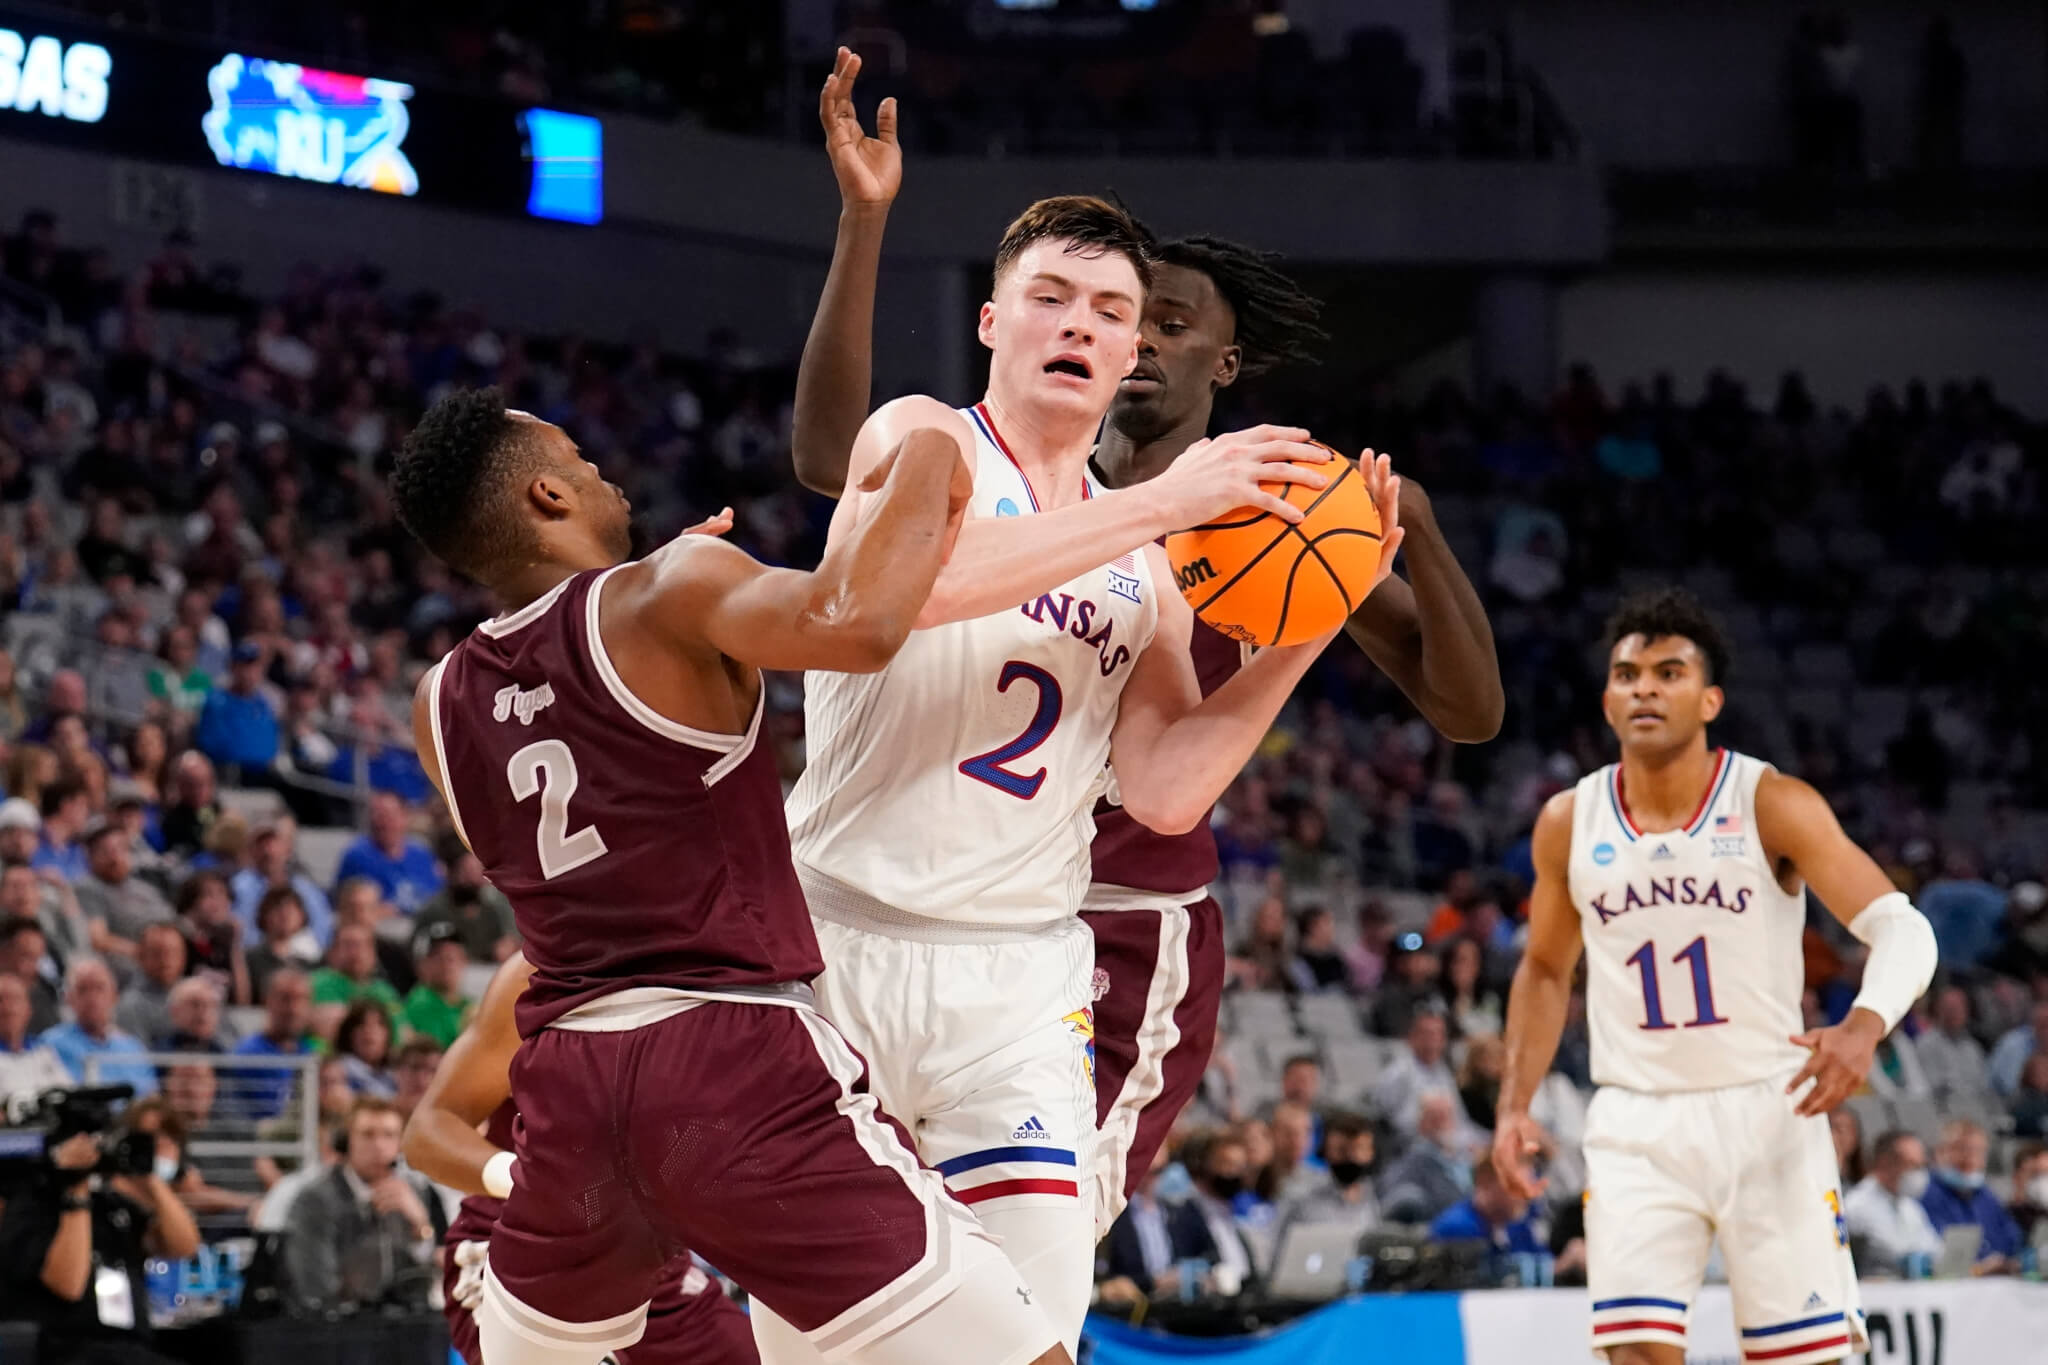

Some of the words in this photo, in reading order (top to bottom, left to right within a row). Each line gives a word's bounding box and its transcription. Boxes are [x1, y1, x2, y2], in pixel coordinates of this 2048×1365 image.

[958, 660, 1062, 800] 2
[507, 739, 608, 880] 2
[1591, 877, 1754, 926] KANSAS
[1626, 936, 1729, 1030] 11
[1012, 1130, 1051, 1140] adidas
